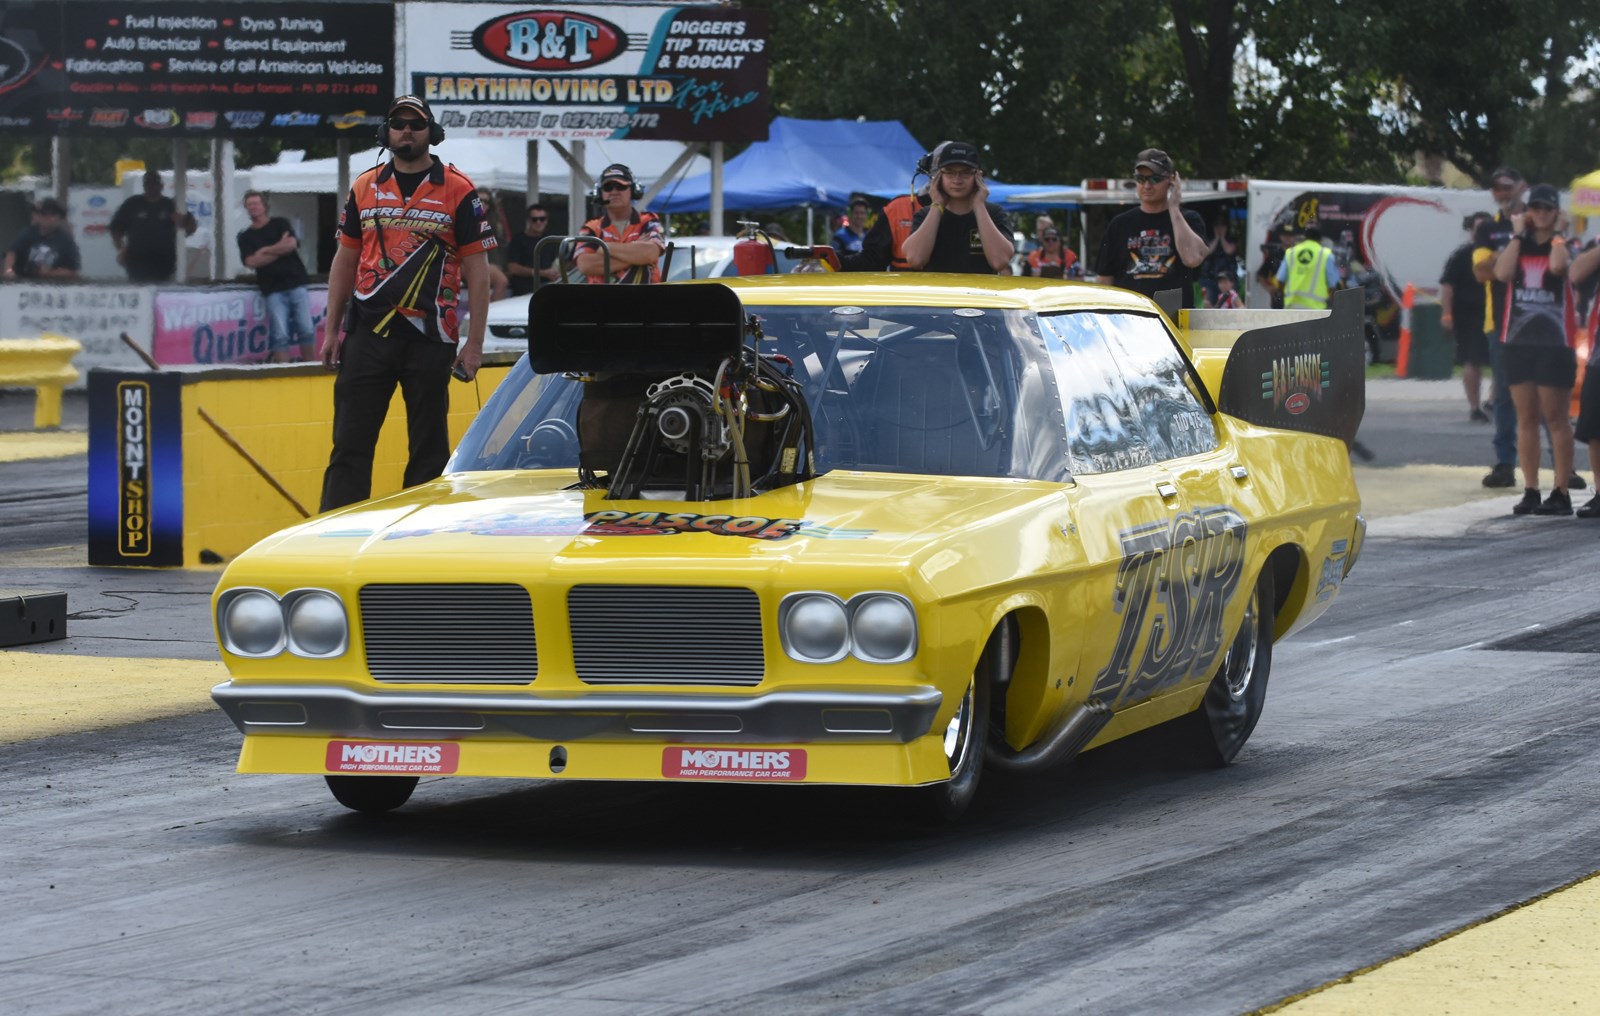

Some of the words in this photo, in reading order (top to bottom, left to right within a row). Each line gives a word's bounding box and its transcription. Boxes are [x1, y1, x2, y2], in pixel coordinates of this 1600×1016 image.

[125, 14, 155, 29] Fuel
[157, 15, 217, 30] Injection
[240, 16, 276, 33] Dyno
[280, 16, 324, 34] Tuning
[670, 20, 746, 35] DIGGER'S
[102, 36, 136, 50] Auto
[137, 36, 201, 51] Electrical
[224, 36, 269, 52] Speed
[272, 38, 346, 54] Equipment
[506, 18, 599, 63] B&T
[665, 38, 693, 52] TIP
[697, 38, 765, 53] TRUCK'S
[65, 58, 144, 73] Fabrication
[168, 58, 217, 73] Service
[219, 59, 235, 73] of
[238, 59, 256, 73] all
[258, 59, 324, 74] American
[327, 60, 383, 75] Vehicles
[658, 55, 671, 69] &
[675, 55, 744, 69] BOBCAT
[425, 76, 618, 102] EARTHMOVING
[627, 79, 674, 103] LTD
[670, 78, 724, 109] For
[541, 114, 559, 128] or
[586, 509, 802, 541] PASCOE
[1088, 504, 1248, 705] TSR
[341, 744, 442, 764] MOTHERS
[681, 750, 790, 770] MOTHERS
[698, 769, 754, 777] PERFORMANCE
[771, 770, 791, 778] CARE
